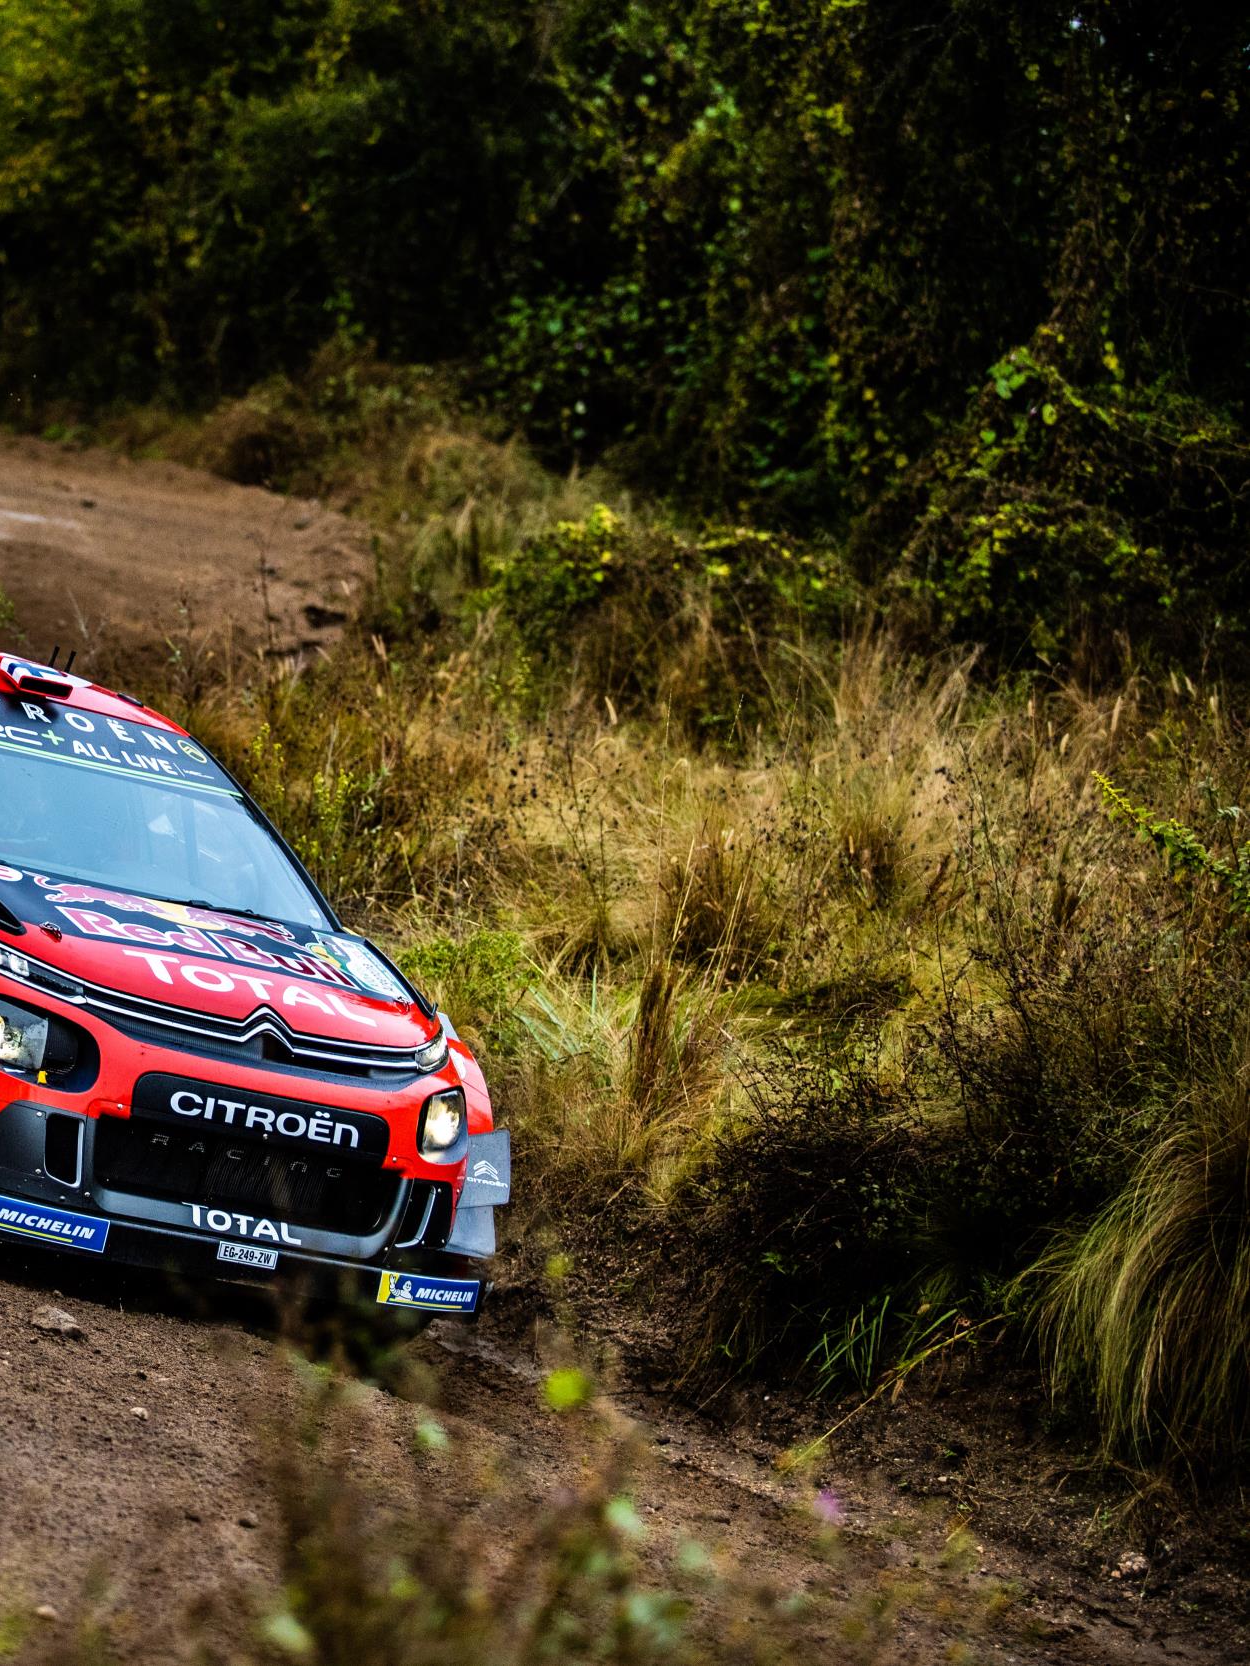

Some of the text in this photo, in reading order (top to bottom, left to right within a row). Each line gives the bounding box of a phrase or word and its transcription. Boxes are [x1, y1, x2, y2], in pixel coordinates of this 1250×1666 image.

[72, 740, 121, 764] ALL
[121, 750, 178, 776] LIVE
[55, 905, 228, 958] Red
[207, 931, 362, 991] Bull
[123, 949, 377, 1027] TOTAL
[170, 1091, 360, 1149] CITROËN
[466, 1176, 509, 1188] CITROËN
[181, 1201, 302, 1246] TOTAL
[223, 1245, 272, 1265] EG-249-ZW
[415, 1287, 474, 1303] MICHELIN
